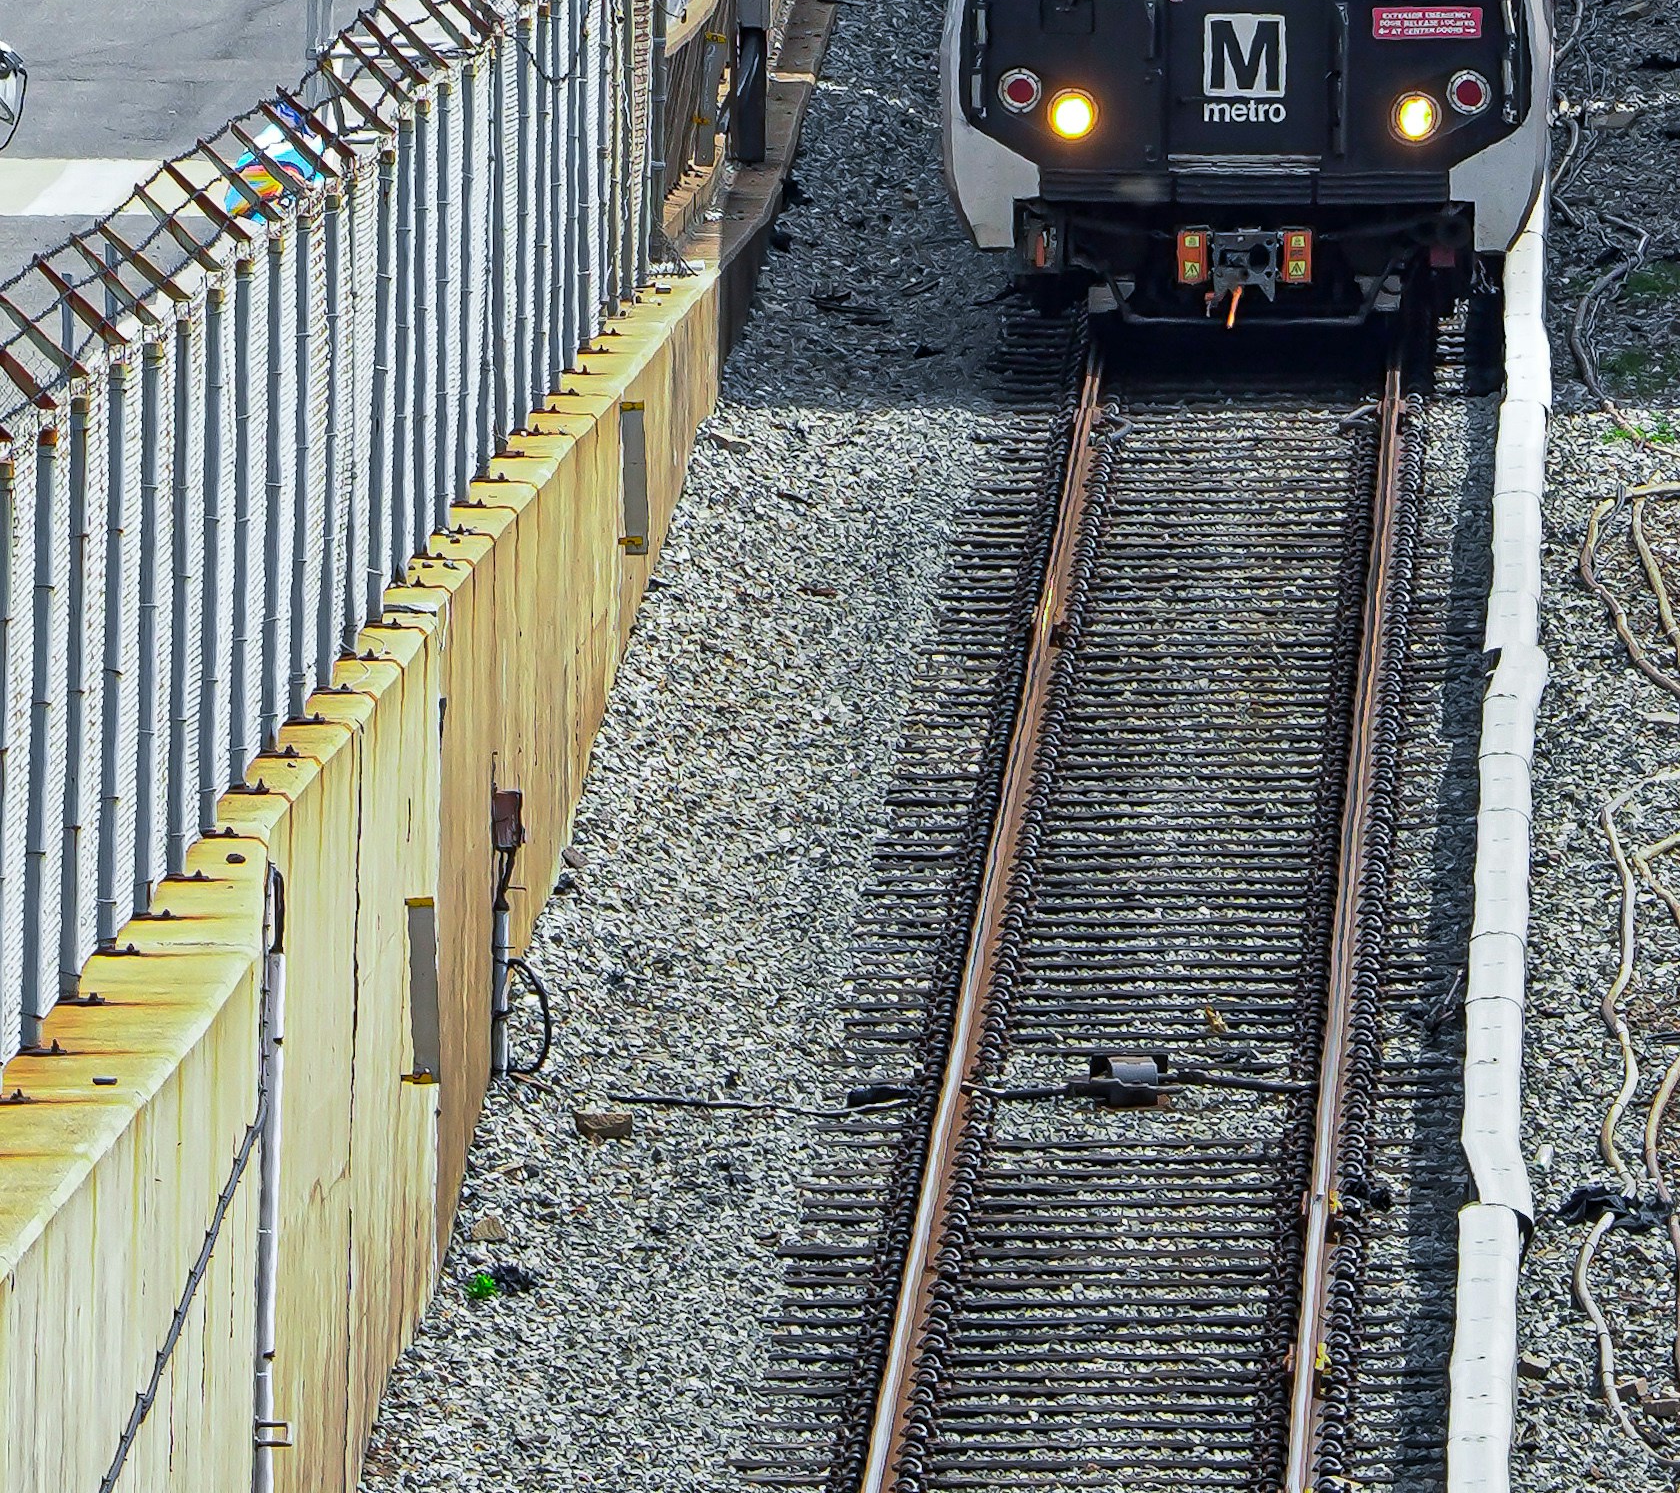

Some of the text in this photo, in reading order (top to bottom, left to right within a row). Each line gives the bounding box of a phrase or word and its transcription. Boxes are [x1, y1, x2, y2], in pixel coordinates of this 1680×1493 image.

[1403, 27, 1435, 36] CENTER
[1210, 20, 1280, 91] M
[1203, 99, 1287, 123] metro
